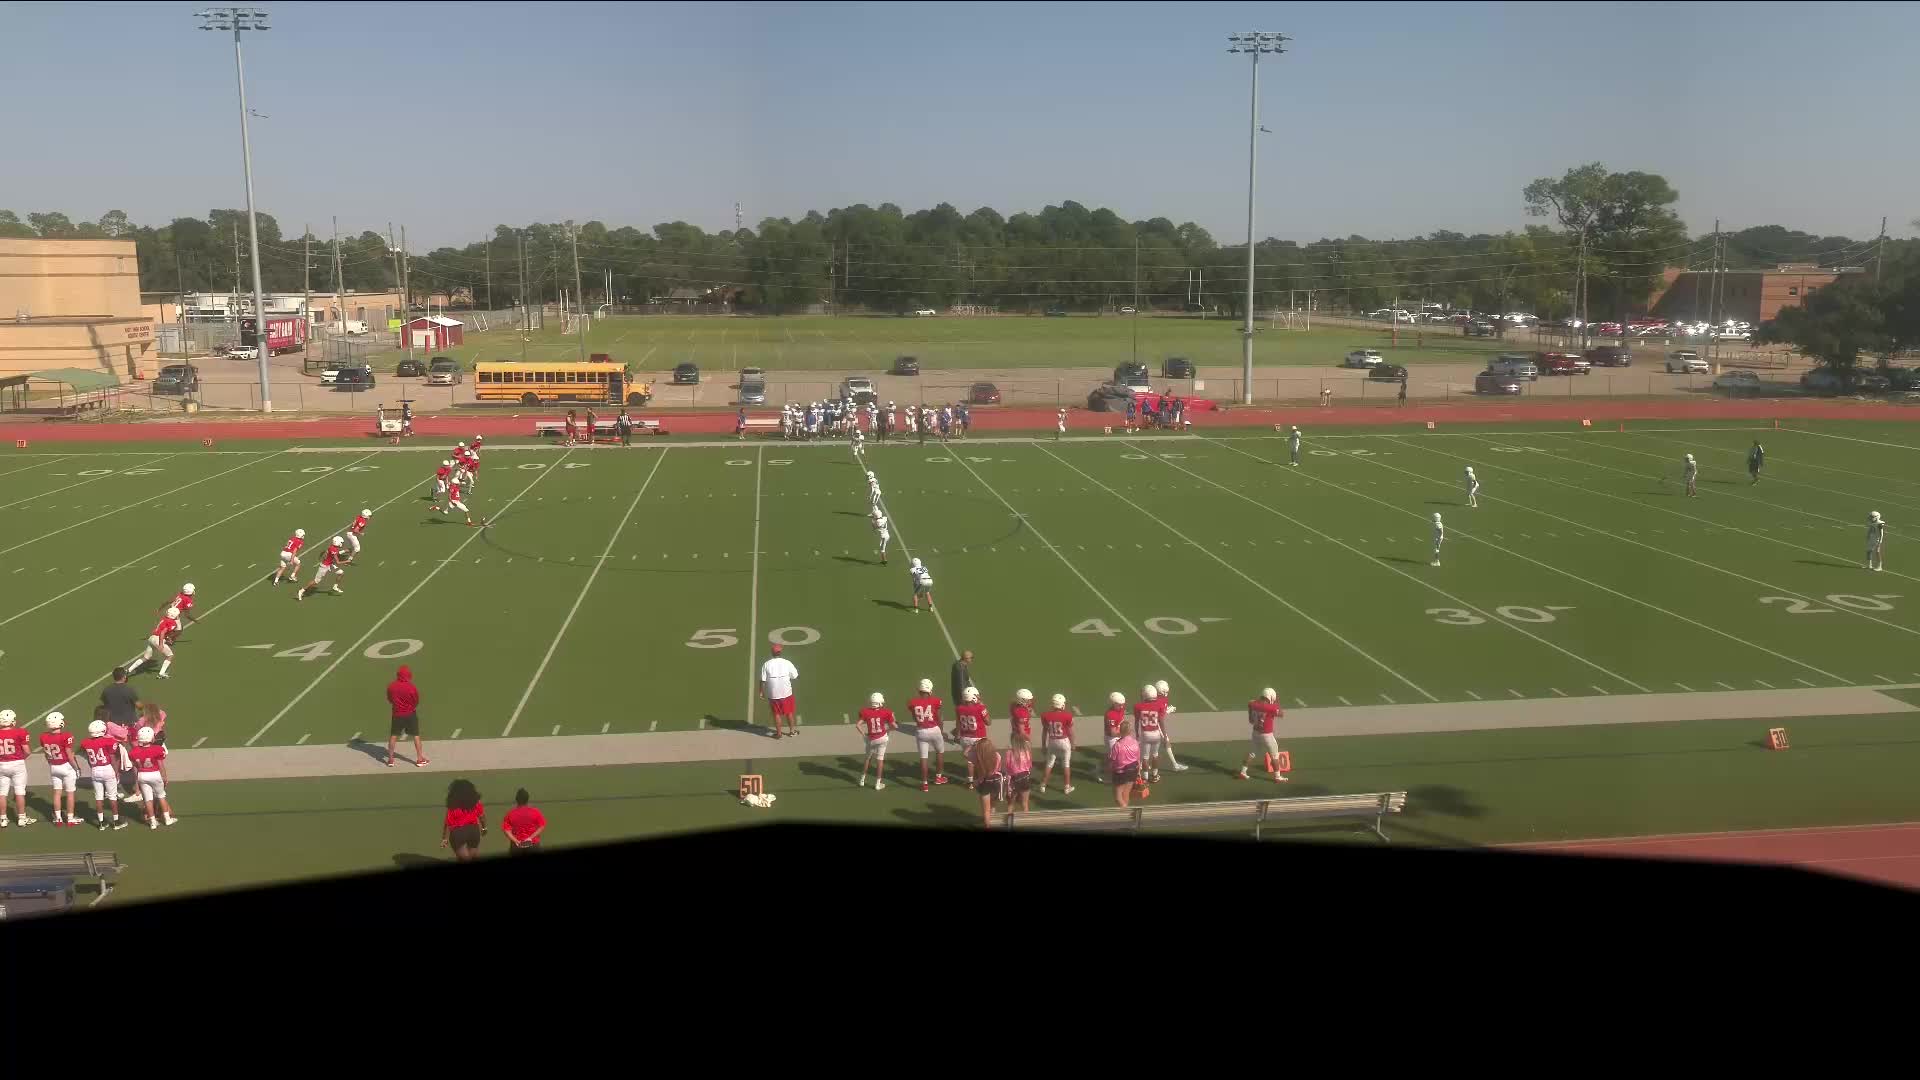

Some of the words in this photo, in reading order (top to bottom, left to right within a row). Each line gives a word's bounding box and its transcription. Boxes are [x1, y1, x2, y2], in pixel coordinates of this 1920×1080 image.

[18, 440, 25, 448] 10
[1759, 594, 1896, 614] 20
[1425, 605, 1556, 625] 30
[1069, 616, 1199, 637] 40
[685, 626, 821, 649] 50
[271, 638, 425, 662] 40
[914, 704, 934, 723] 94
[1140, 711, 1159, 728] 53
[870, 717, 882, 734] 11
[1772, 730, 1788, 747] 30
[741, 777, 761, 796] 50
